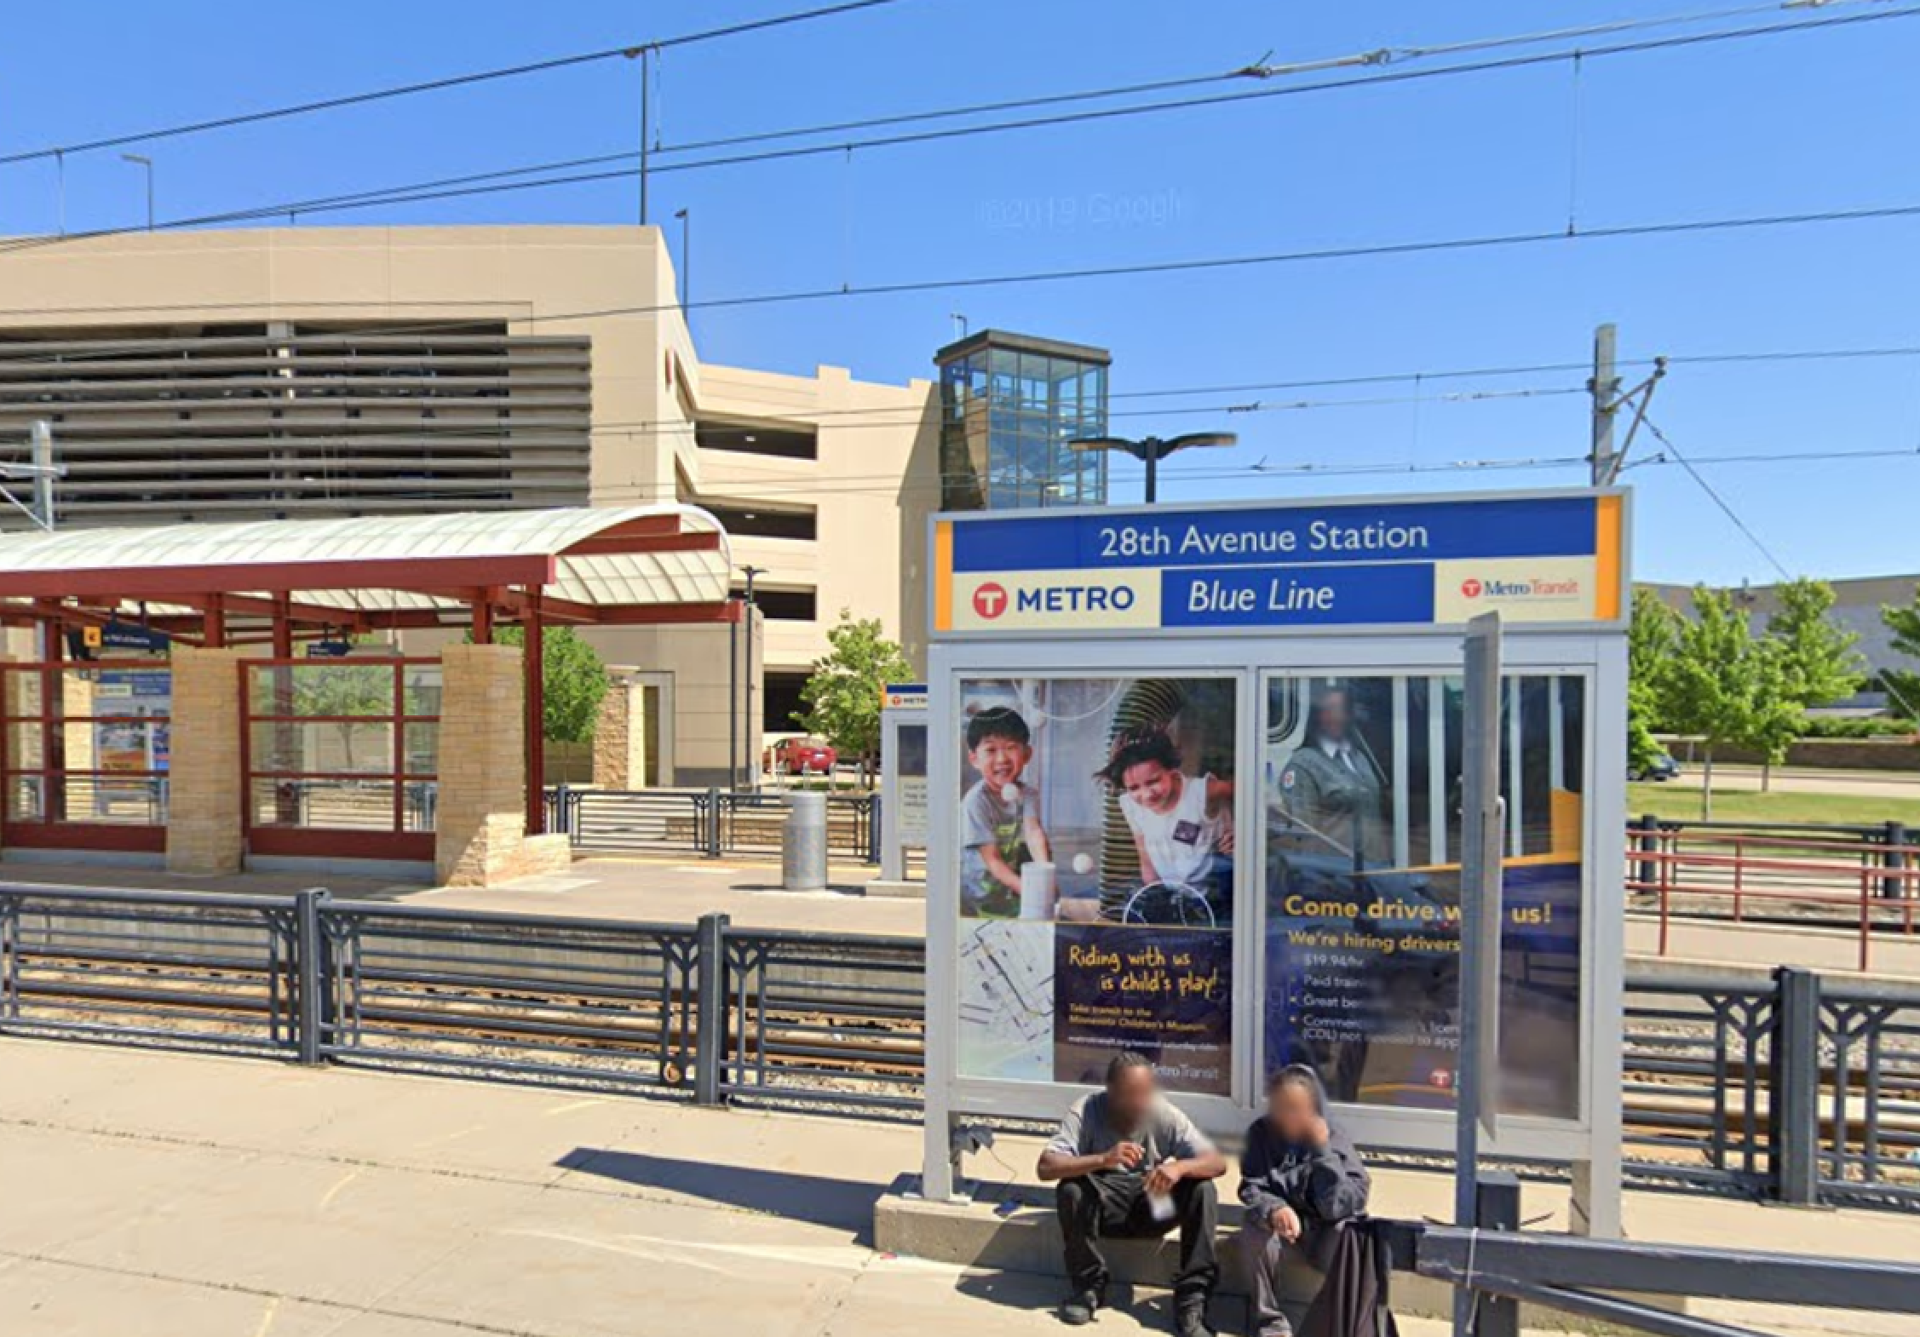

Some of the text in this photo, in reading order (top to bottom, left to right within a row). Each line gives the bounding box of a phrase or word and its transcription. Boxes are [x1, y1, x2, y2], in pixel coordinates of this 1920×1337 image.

[1100, 519, 1429, 557] 28th Avenue Station
[1016, 585, 1135, 612] METRO
[1188, 578, 1335, 613] Blue Line
[1285, 895, 1359, 918] Come
[1367, 896, 1436, 920] drive
[1511, 902, 1552, 924] us!
[1288, 929, 1339, 947] We're
[1344, 931, 1394, 953] hiring
[1069, 945, 1192, 972] Riding with us
[1101, 974, 1114, 991] is
[1121, 969, 1172, 992] child's
[1178, 967, 1219, 999] play!
[1304, 974, 1332, 988] Paid
[1304, 994, 1339, 1008] Great
